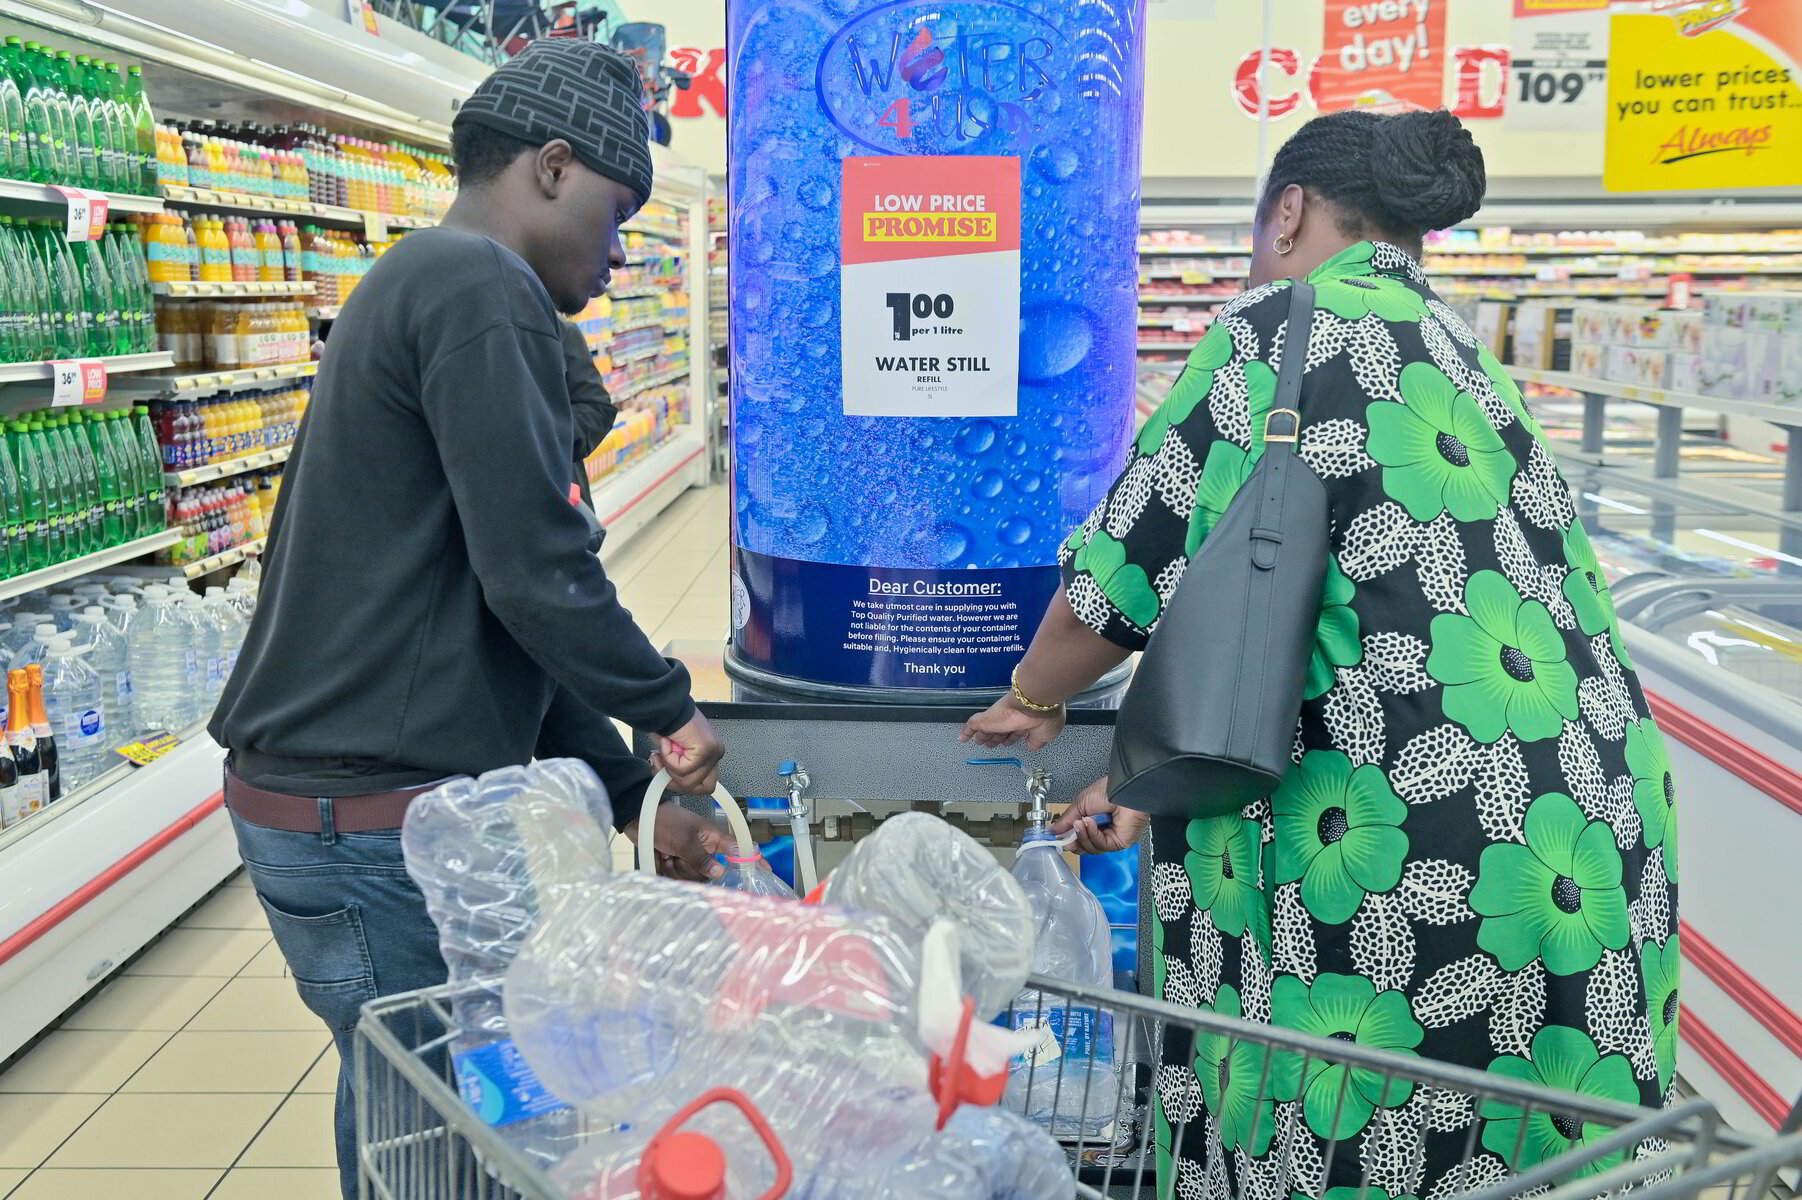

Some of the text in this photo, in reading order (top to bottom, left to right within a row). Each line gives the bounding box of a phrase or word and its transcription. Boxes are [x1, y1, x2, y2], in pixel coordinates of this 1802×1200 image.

[1341, 24, 1429, 72] day!
[1635, 65, 1791, 91] lower prices
[1617, 100, 1660, 121] you
[1672, 97, 1715, 112] can
[880, 98, 919, 138] 4
[1651, 124, 1772, 164] Always
[874, 195, 986, 212] LOW PRICE
[867, 217, 993, 237] PROMISE
[912, 328, 930, 336] per
[941, 326, 964, 335] litre
[875, 356, 991, 372] WATER STILL
[917, 375, 942, 383] REFILL
[869, 578, 1002, 595] Dear Customer:
[853, 600, 866, 609] We
[867, 602, 884, 610] take
[885, 603, 914, 611] utmost
[935, 603, 943, 611] in
[944, 603, 983, 613] supplying
[984, 604, 999, 612] you
[1000, 602, 1017, 610] with
[851, 611, 866, 619] Top
[867, 612, 895, 621] Quality
[896, 614, 928, 622] Purified
[850, 622, 864, 630] not
[865, 622, 886, 631] liable
[887, 623, 899, 632] for
[900, 624, 914, 632] the
[952, 625, 961, 633] of
[962, 626, 981, 634] your
[981, 624, 1018, 632] container
[848, 631, 873, 641] before
[874, 633, 899, 643] filling.
[900, 634, 927, 643] Please
[957, 637, 975, 645] your
[976, 634, 1013, 643] container
[1013, 633, 1021, 641] is
[843, 642, 1026, 655] suitable and, Hygienically clean for water refills.
[904, 662, 966, 676] Thank you
